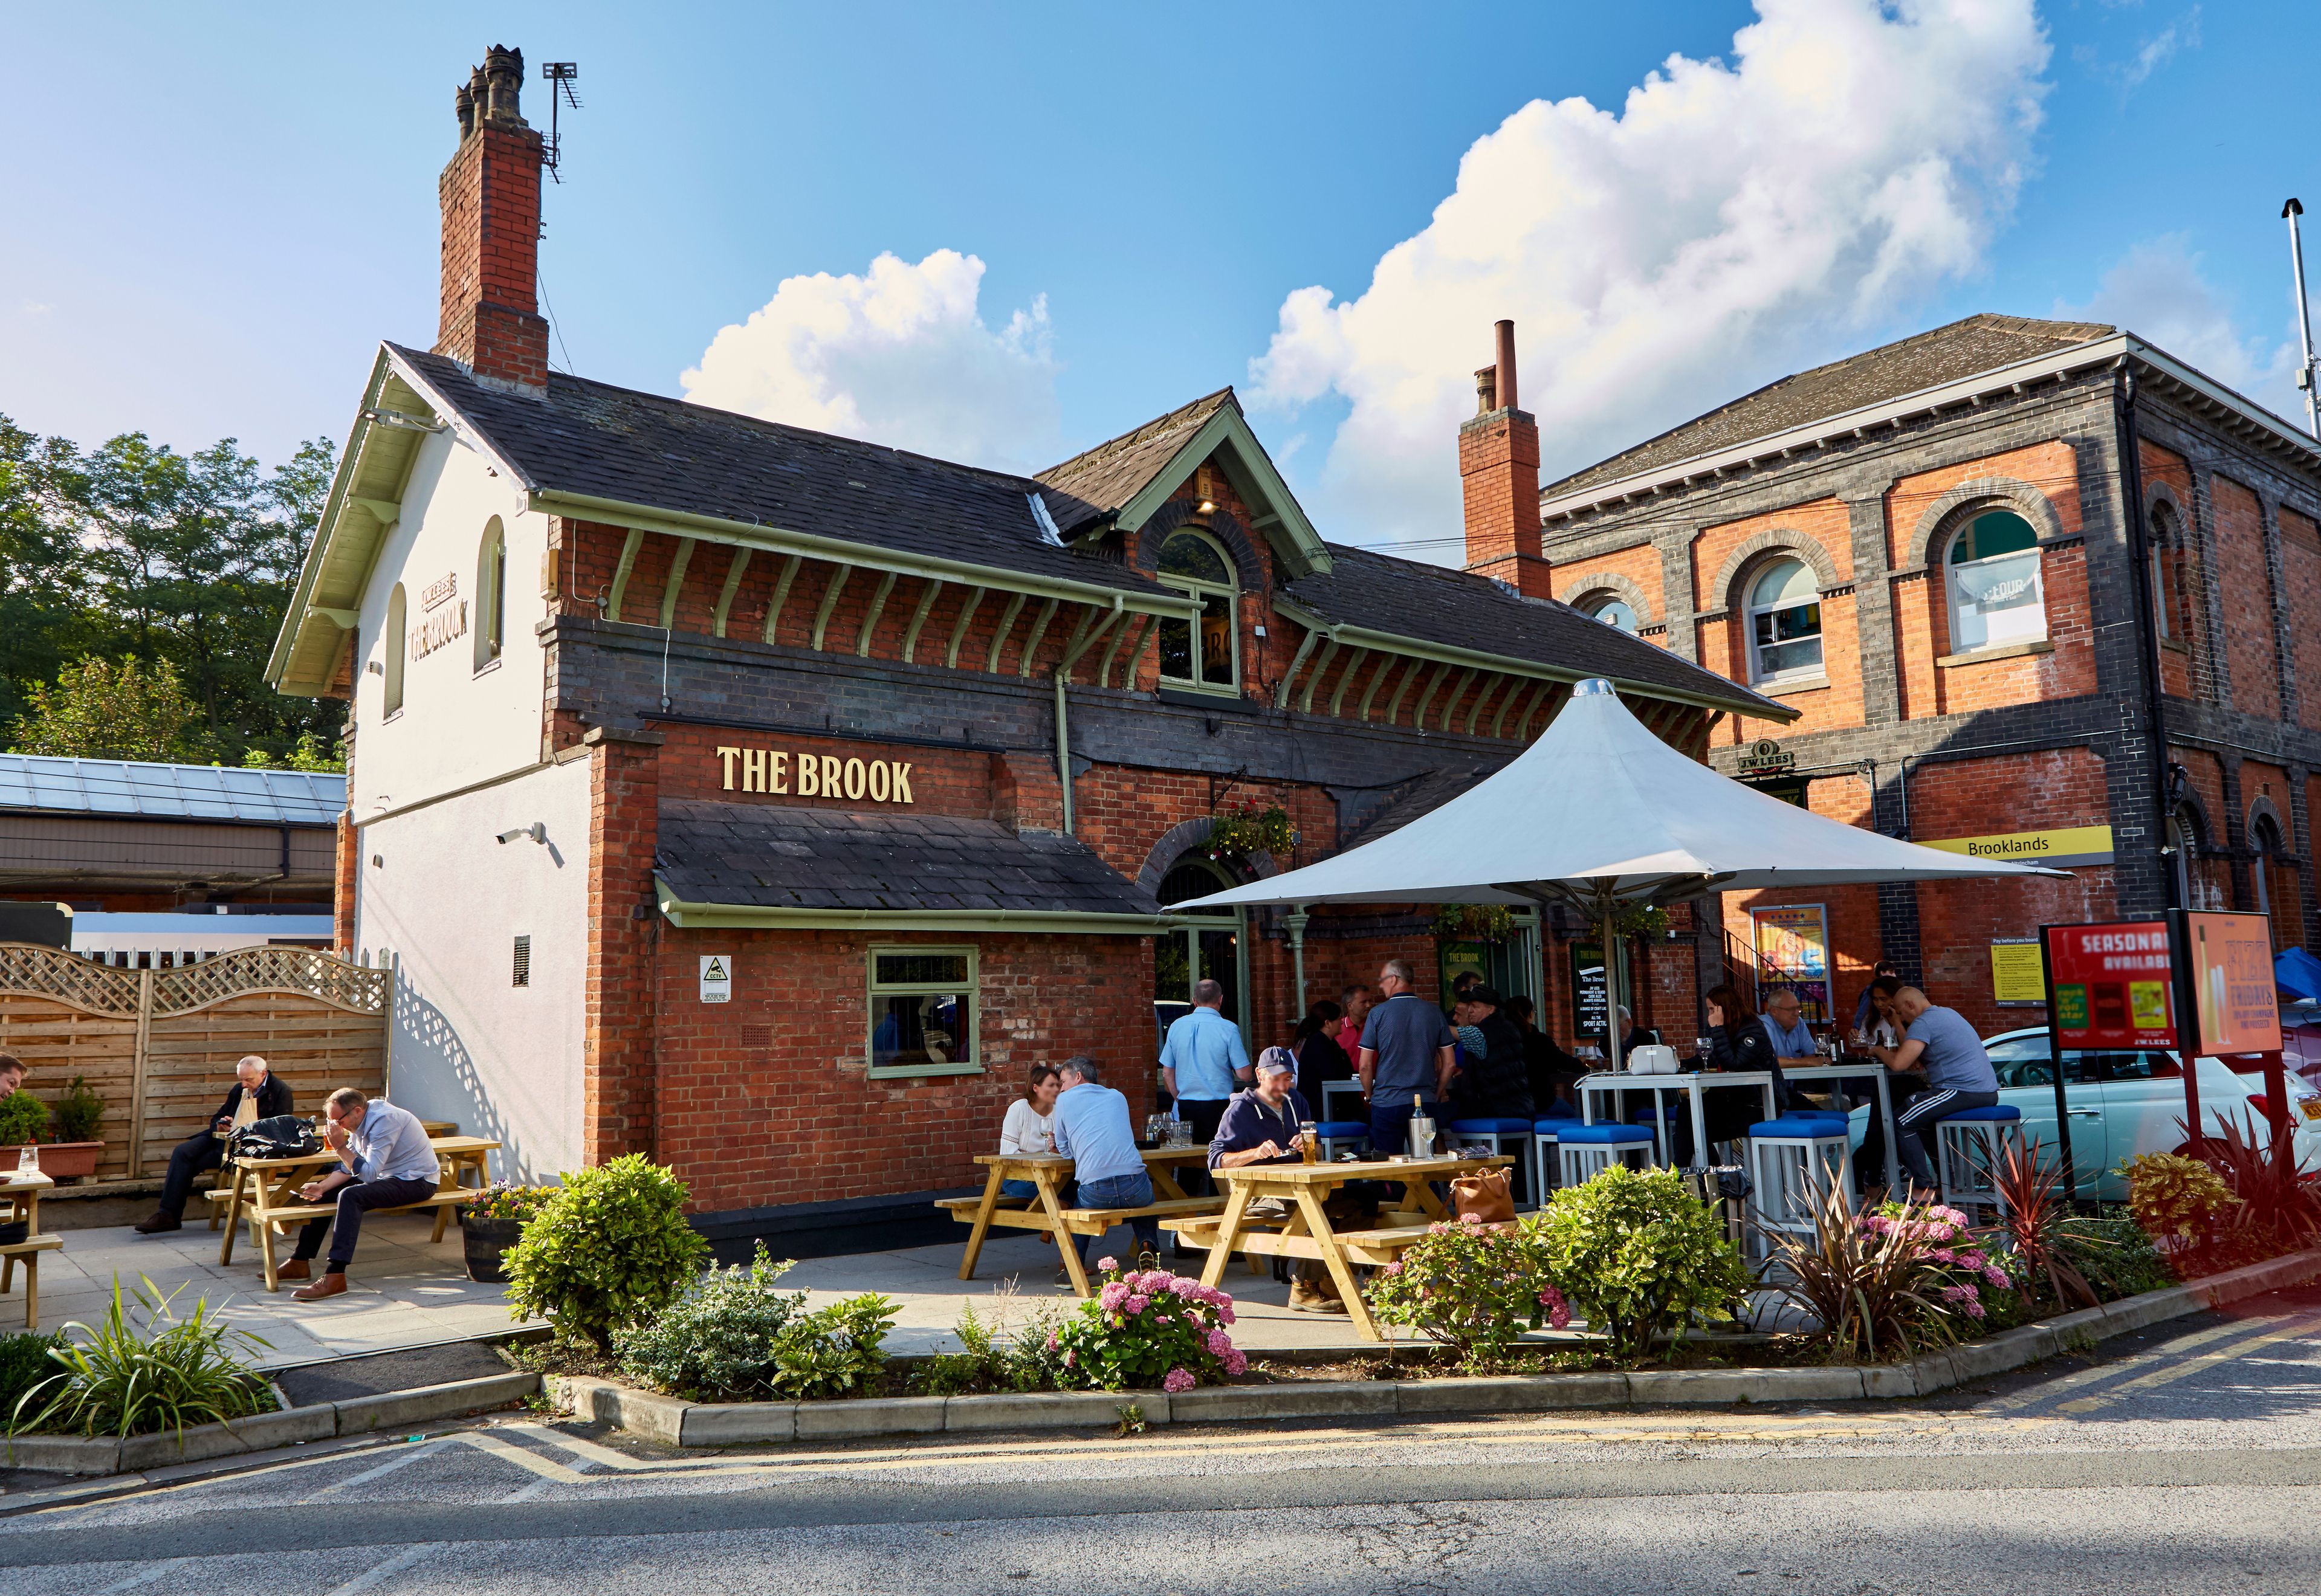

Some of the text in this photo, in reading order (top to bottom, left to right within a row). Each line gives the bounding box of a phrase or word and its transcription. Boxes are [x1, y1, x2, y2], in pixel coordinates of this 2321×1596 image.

[717, 746, 914, 803] THE BROOK
[1968, 837, 2048, 856] Brooklands
[1449, 953, 1478, 962] THE BROOK
[1580, 950, 1603, 959] THE BROO
[1802, 949, 1824, 976] 5
[2230, 984, 2273, 1007] FRIDAYS
